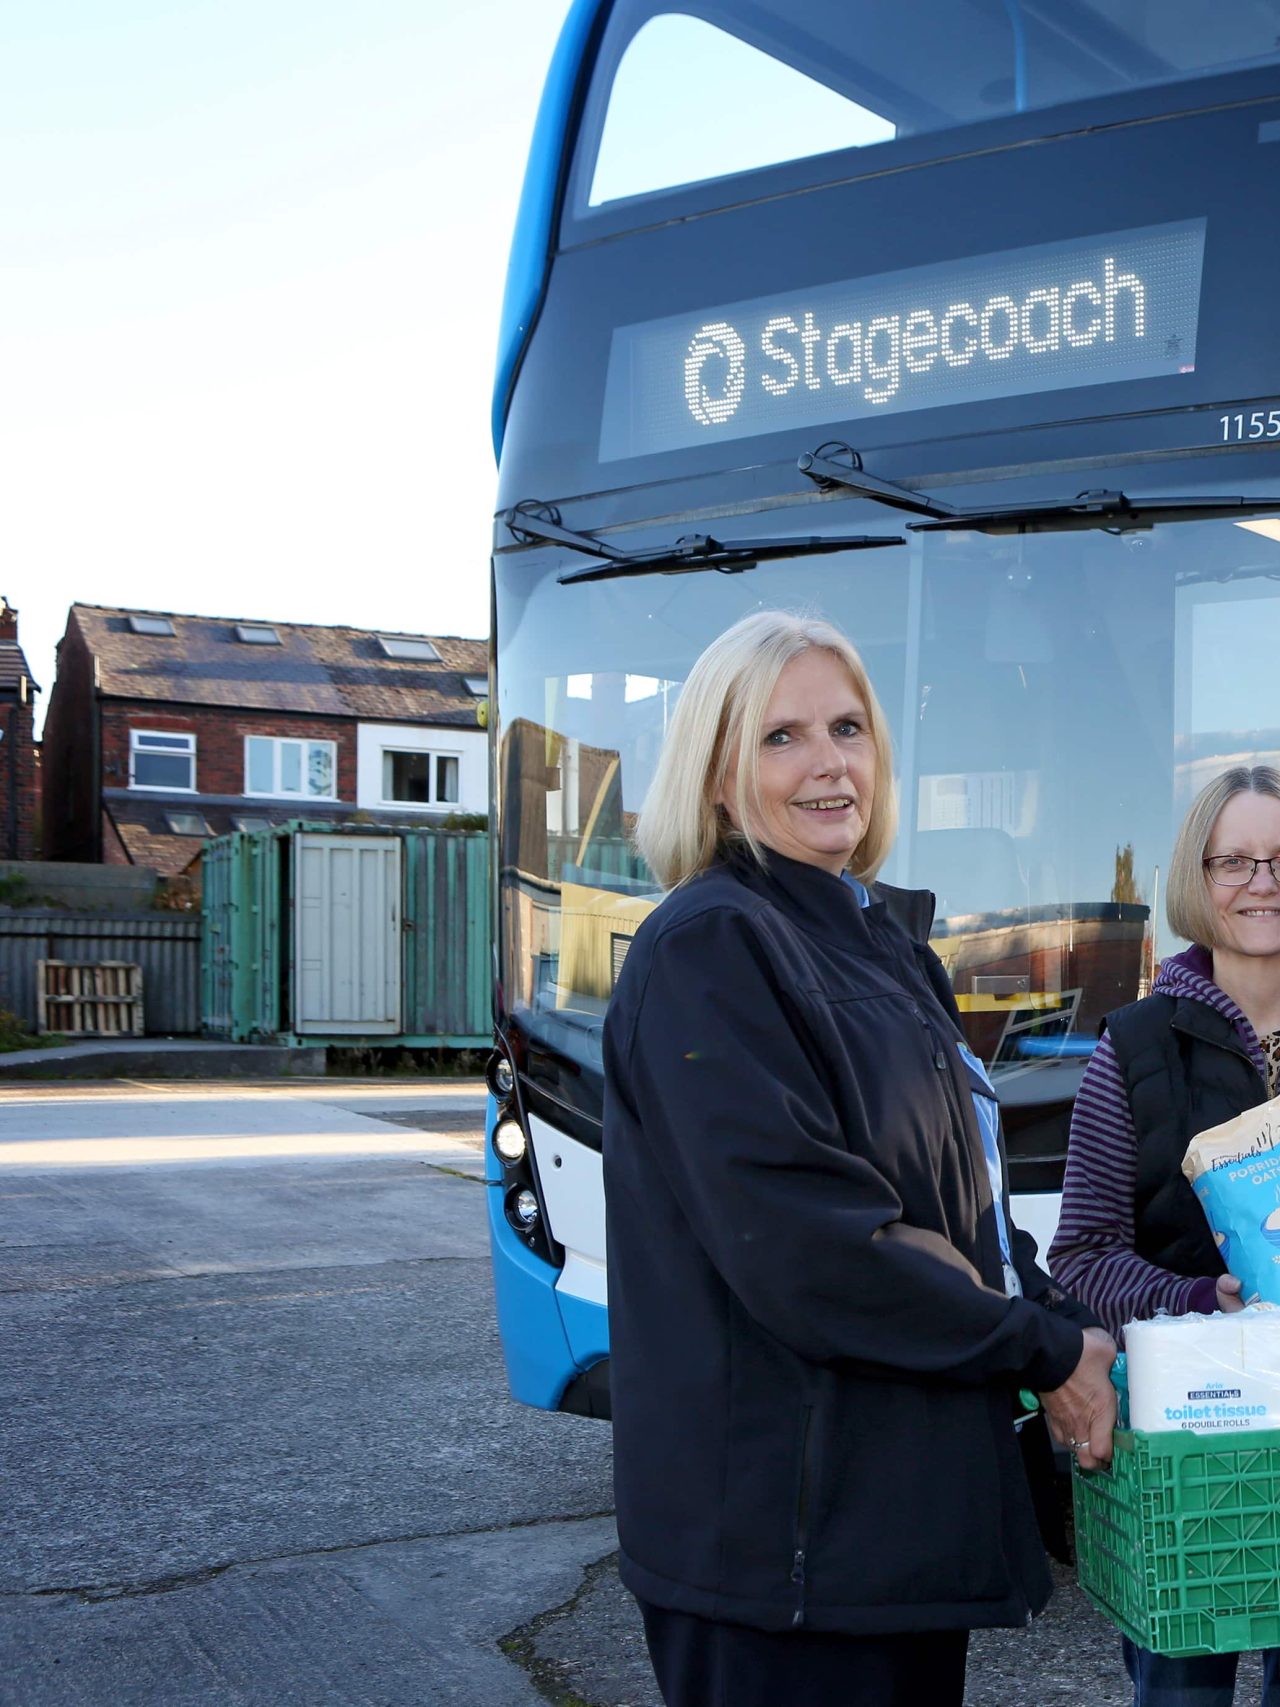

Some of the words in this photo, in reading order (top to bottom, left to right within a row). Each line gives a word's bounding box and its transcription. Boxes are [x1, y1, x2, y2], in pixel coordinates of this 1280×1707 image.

[762, 258, 1146, 404] Stagecoach
[1211, 1145, 1262, 1172] Essentials
[1189, 1390, 1240, 1400] ESSENTIALS
[1164, 1404, 1212, 1420] toilet
[1213, 1403, 1266, 1418] tissue
[1181, 1421, 1187, 1429] 6
[1188, 1420, 1222, 1429] DOUBLE
[1223, 1419, 1250, 1427] ROLLS
